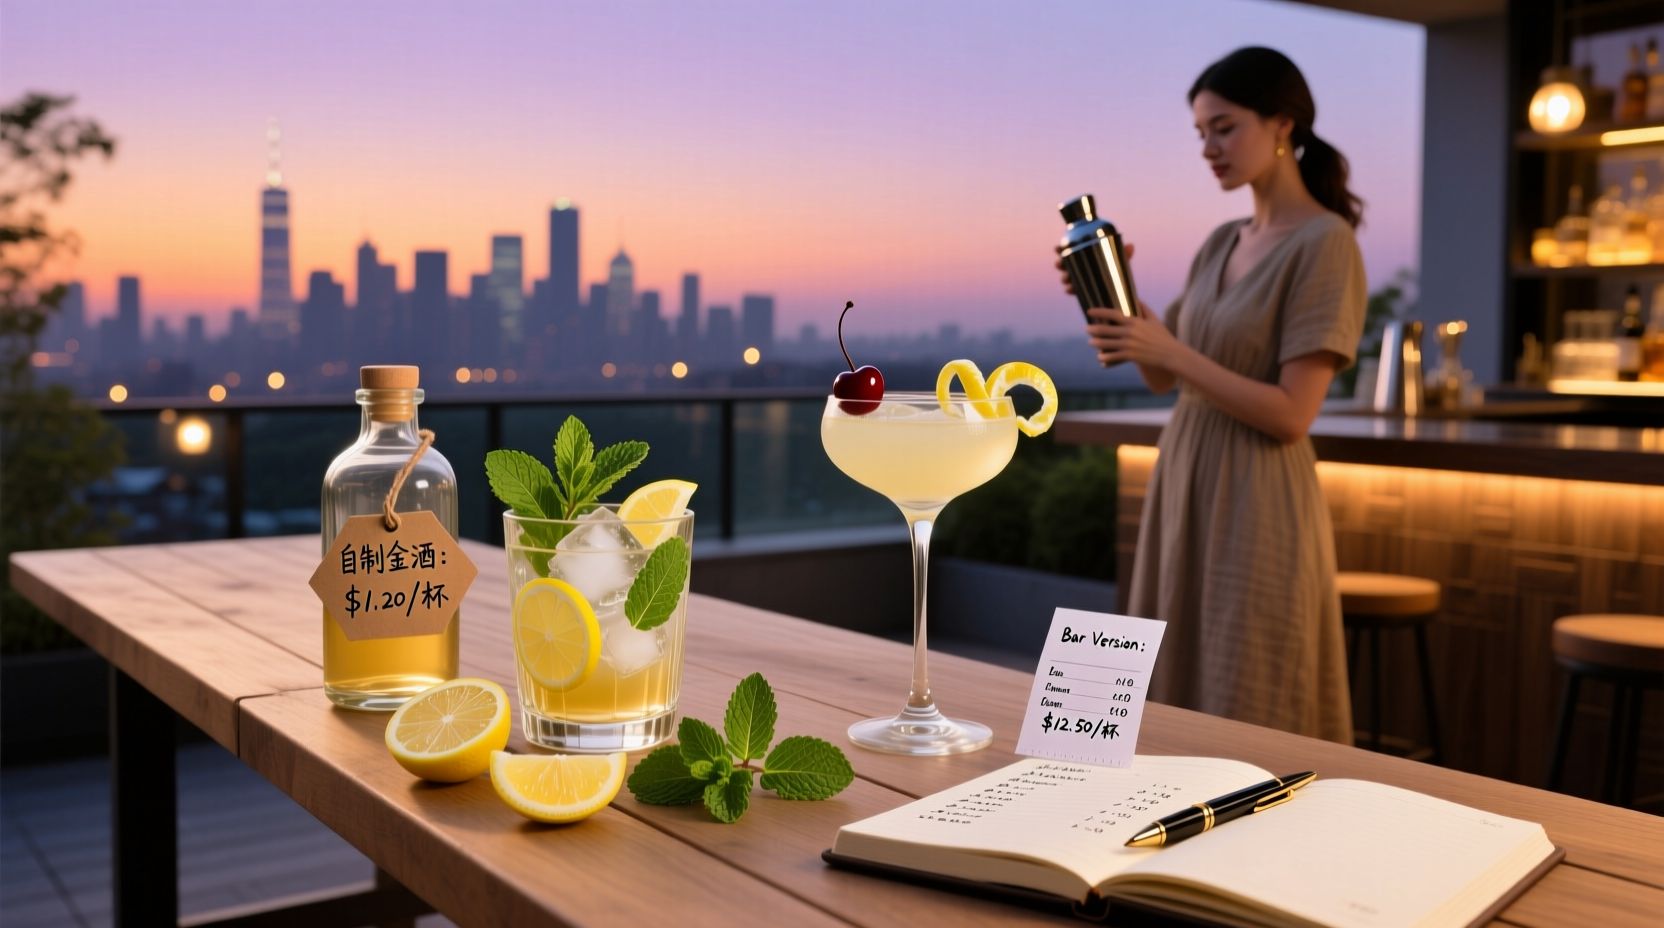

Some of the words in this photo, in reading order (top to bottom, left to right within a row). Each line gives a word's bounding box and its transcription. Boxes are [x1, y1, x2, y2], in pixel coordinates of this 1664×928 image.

[340, 540, 447, 575] 自制金酒:
[345, 580, 449, 619] $1.20/杯
[1061, 626, 1086, 643] Bar
[1092, 631, 1146, 652] Version:
[1041, 711, 1120, 740] $12.50/杯
